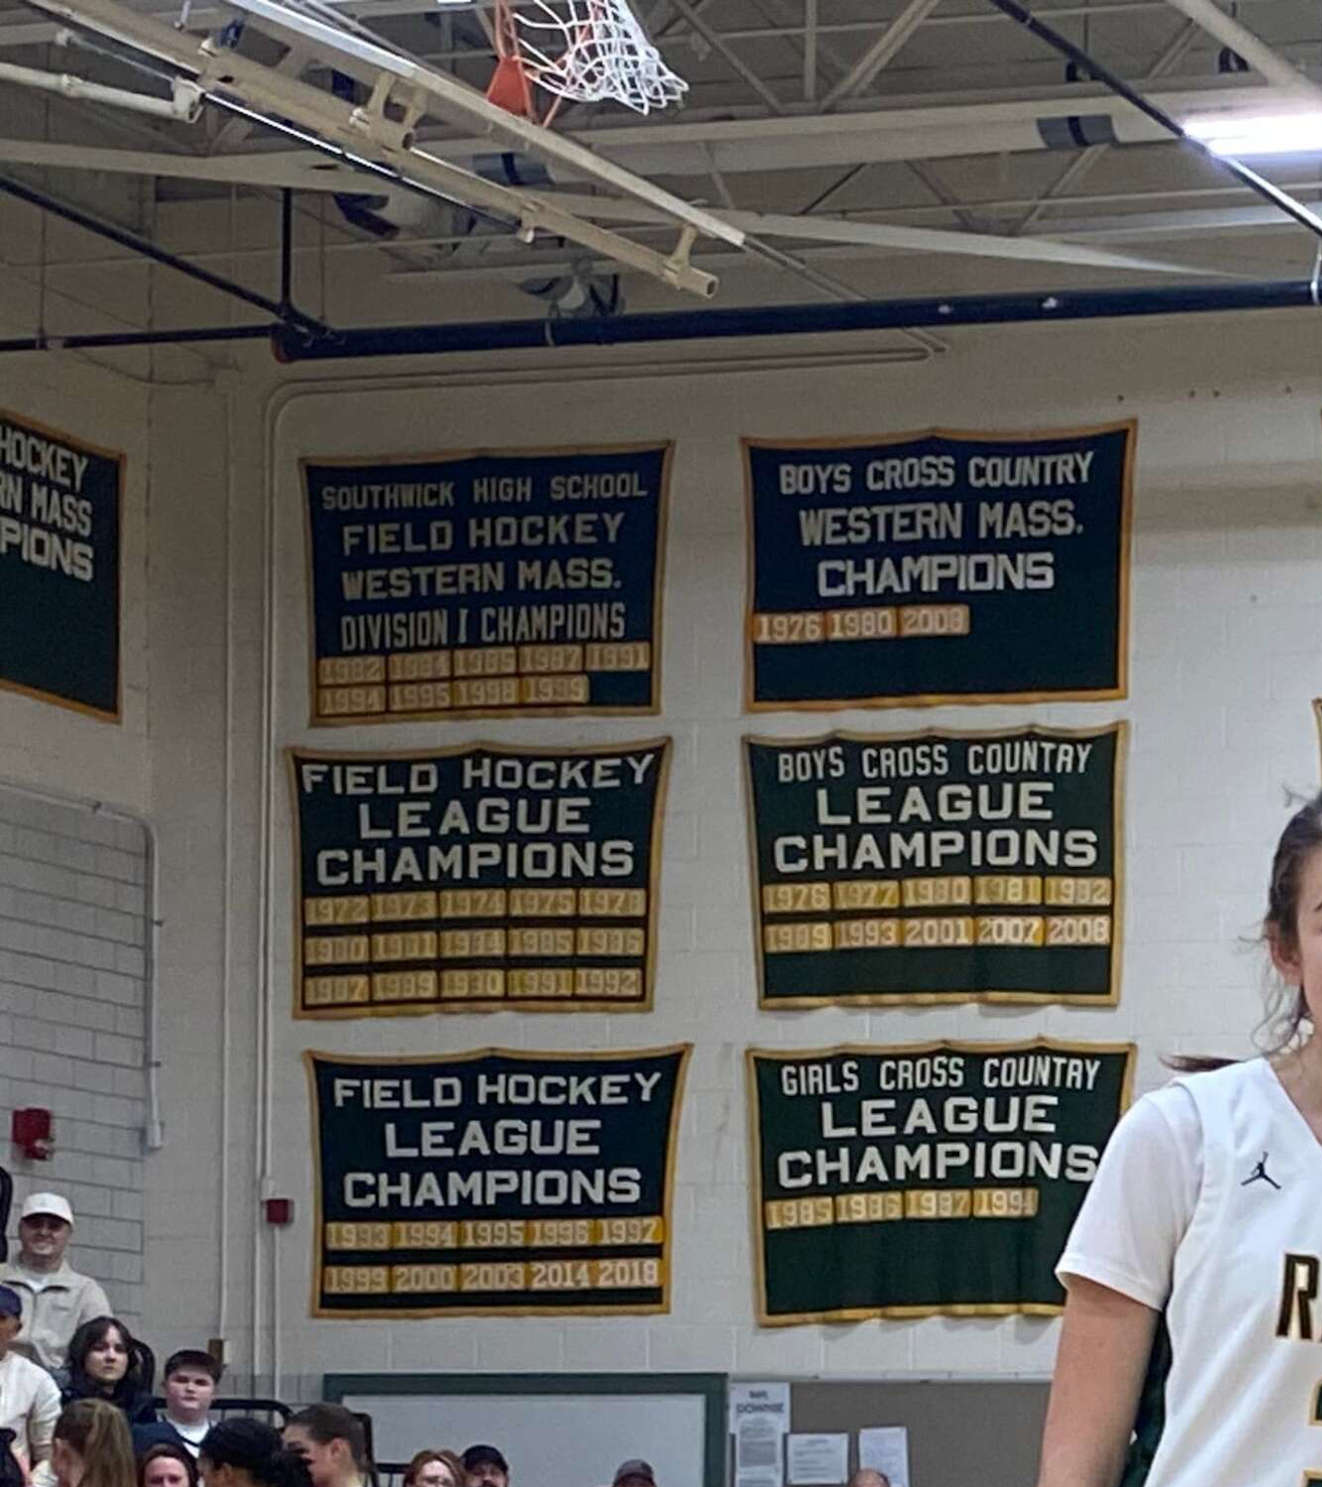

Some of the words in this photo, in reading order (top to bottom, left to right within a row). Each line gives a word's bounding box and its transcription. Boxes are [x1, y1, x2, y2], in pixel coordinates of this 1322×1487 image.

[0, 425, 88, 492] HOCKEY
[779, 463, 852, 496] BOYS
[866, 456, 955, 491] CROSS
[968, 450, 1095, 488] COUNTRY
[31, 482, 92, 537] MASS
[322, 481, 456, 512] SOUTHWICK
[473, 476, 532, 503] HIGH
[551, 471, 647, 501] SCHOOL
[343, 520, 454, 557] FIELD
[469, 512, 625, 550] HOCKEY
[799, 502, 962, 547] WESTERN
[978, 498, 1084, 539] MASS.
[0, 517, 94, 583] PIONS
[342, 559, 505, 601] WESTERN
[518, 556, 622, 591] MASS.
[818, 551, 1056, 598] CHAMPIONS
[341, 608, 448, 651] DIVISION
[459, 608, 468, 644] I
[481, 602, 627, 643] CHAMPIONS
[757, 613, 822, 643] 1976
[829, 610, 896, 639] 1980
[302, 763, 437, 796] FIELD
[462, 754, 655, 790] HOCKEY
[777, 747, 845, 784] BOYS
[862, 744, 949, 780] CROSS
[968, 741, 1094, 776] COUNTRY
[359, 797, 591, 840] LEAGUE
[816, 781, 1056, 826] LEAGUE
[316, 840, 635, 887] CHAMPIONS
[773, 828, 1098, 874] CHAMPIONS
[766, 883, 829, 912] 1976
[838, 919, 899, 948] 1993
[905, 917, 973, 947] 2001
[977, 916, 1041, 944] 2007
[334, 1077, 462, 1109] FIELD
[477, 1072, 661, 1106] HOCKEY
[780, 1061, 859, 1096] GIRLS
[879, 1056, 965, 1092] CROSS
[983, 1056, 1101, 1091] COUNTRY
[385, 1118, 602, 1159] LEAGUE
[820, 1094, 1059, 1139] LEAGUE
[344, 1167, 642, 1208] CHAMPIONS
[777, 1141, 1101, 1190] CHAMPIONS
[464, 1221, 524, 1247] 1995
[600, 1217, 658, 1244] 1997
[530, 1263, 589, 1290] 2014
[599, 1260, 658, 1287] 2018
